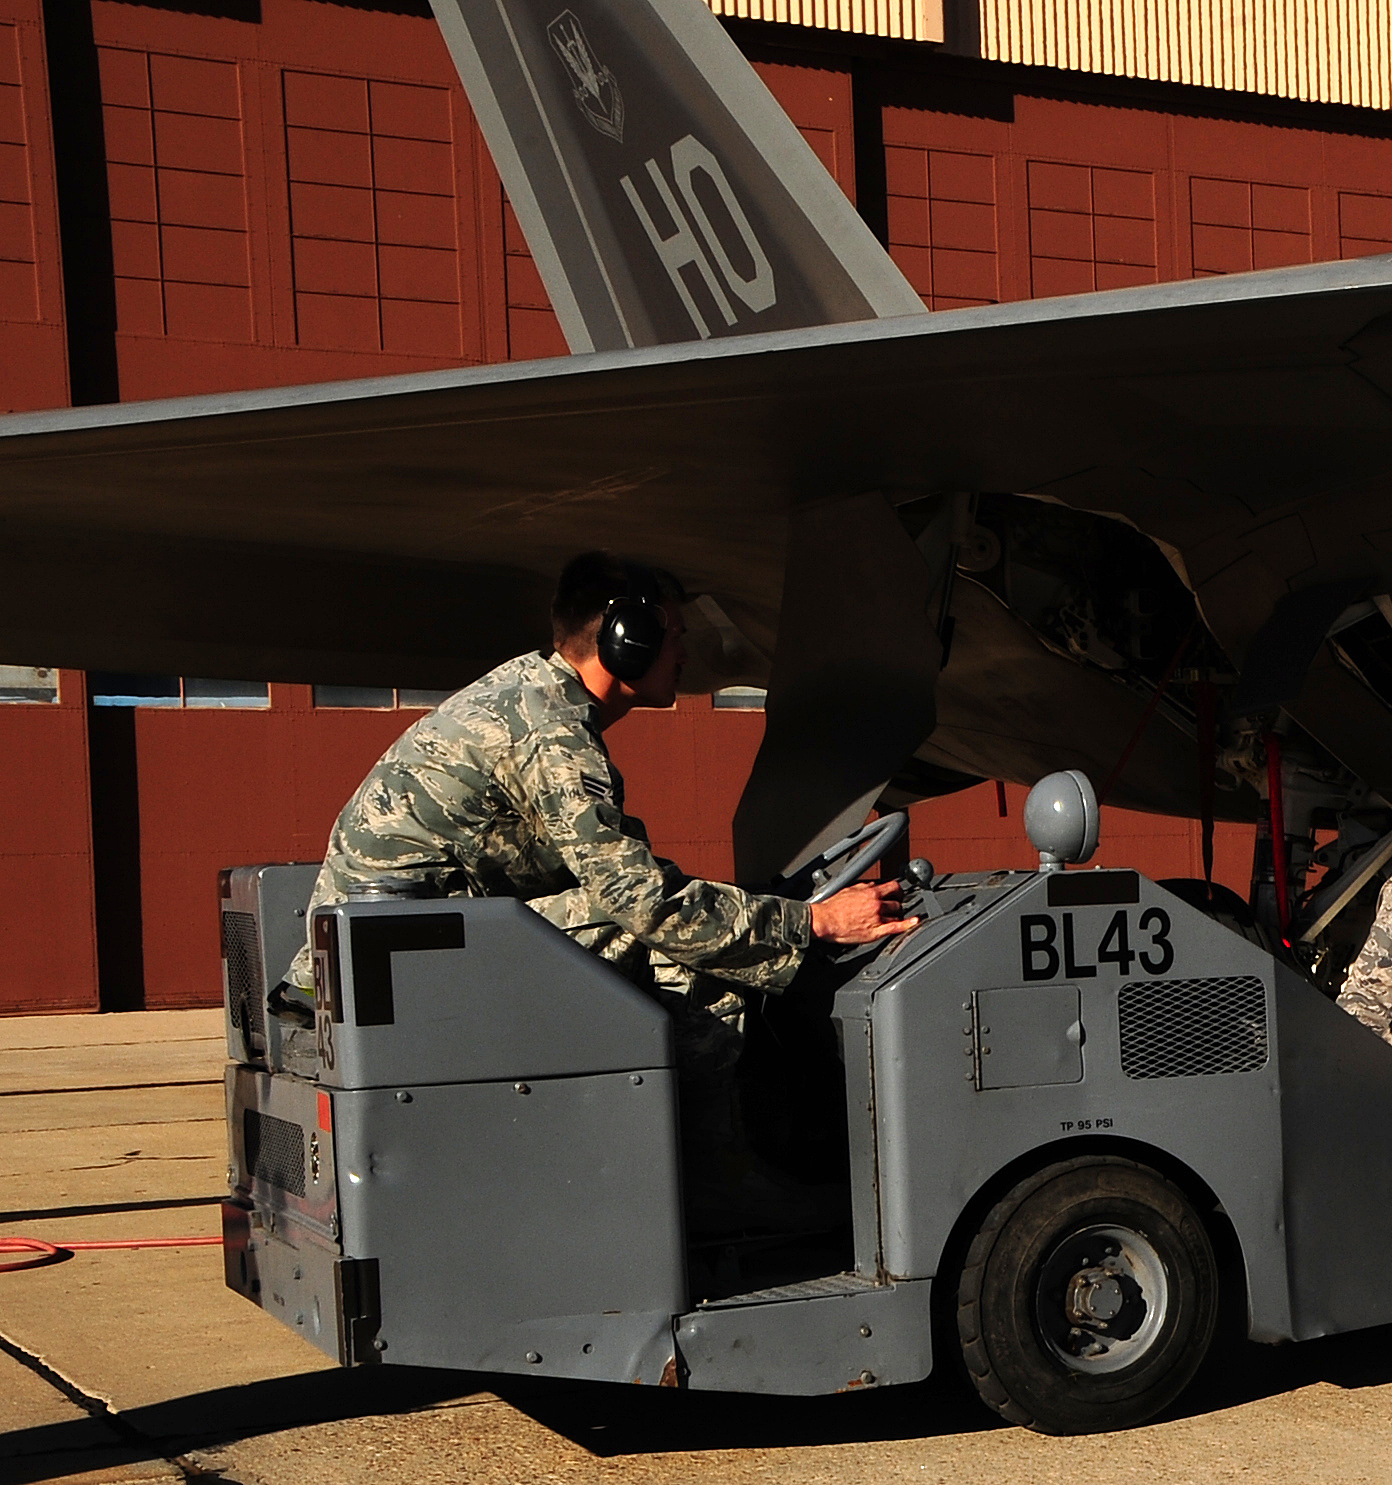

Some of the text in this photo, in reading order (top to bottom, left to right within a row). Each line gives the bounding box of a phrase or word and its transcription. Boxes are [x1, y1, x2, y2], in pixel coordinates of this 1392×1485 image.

[620, 134, 776, 339] HO
[1020, 907, 1174, 981] BL43
[314, 957, 331, 1011] BL
[317, 1014, 335, 1070] 43
[1060, 1118, 1113, 1131] TP 95 PSI
